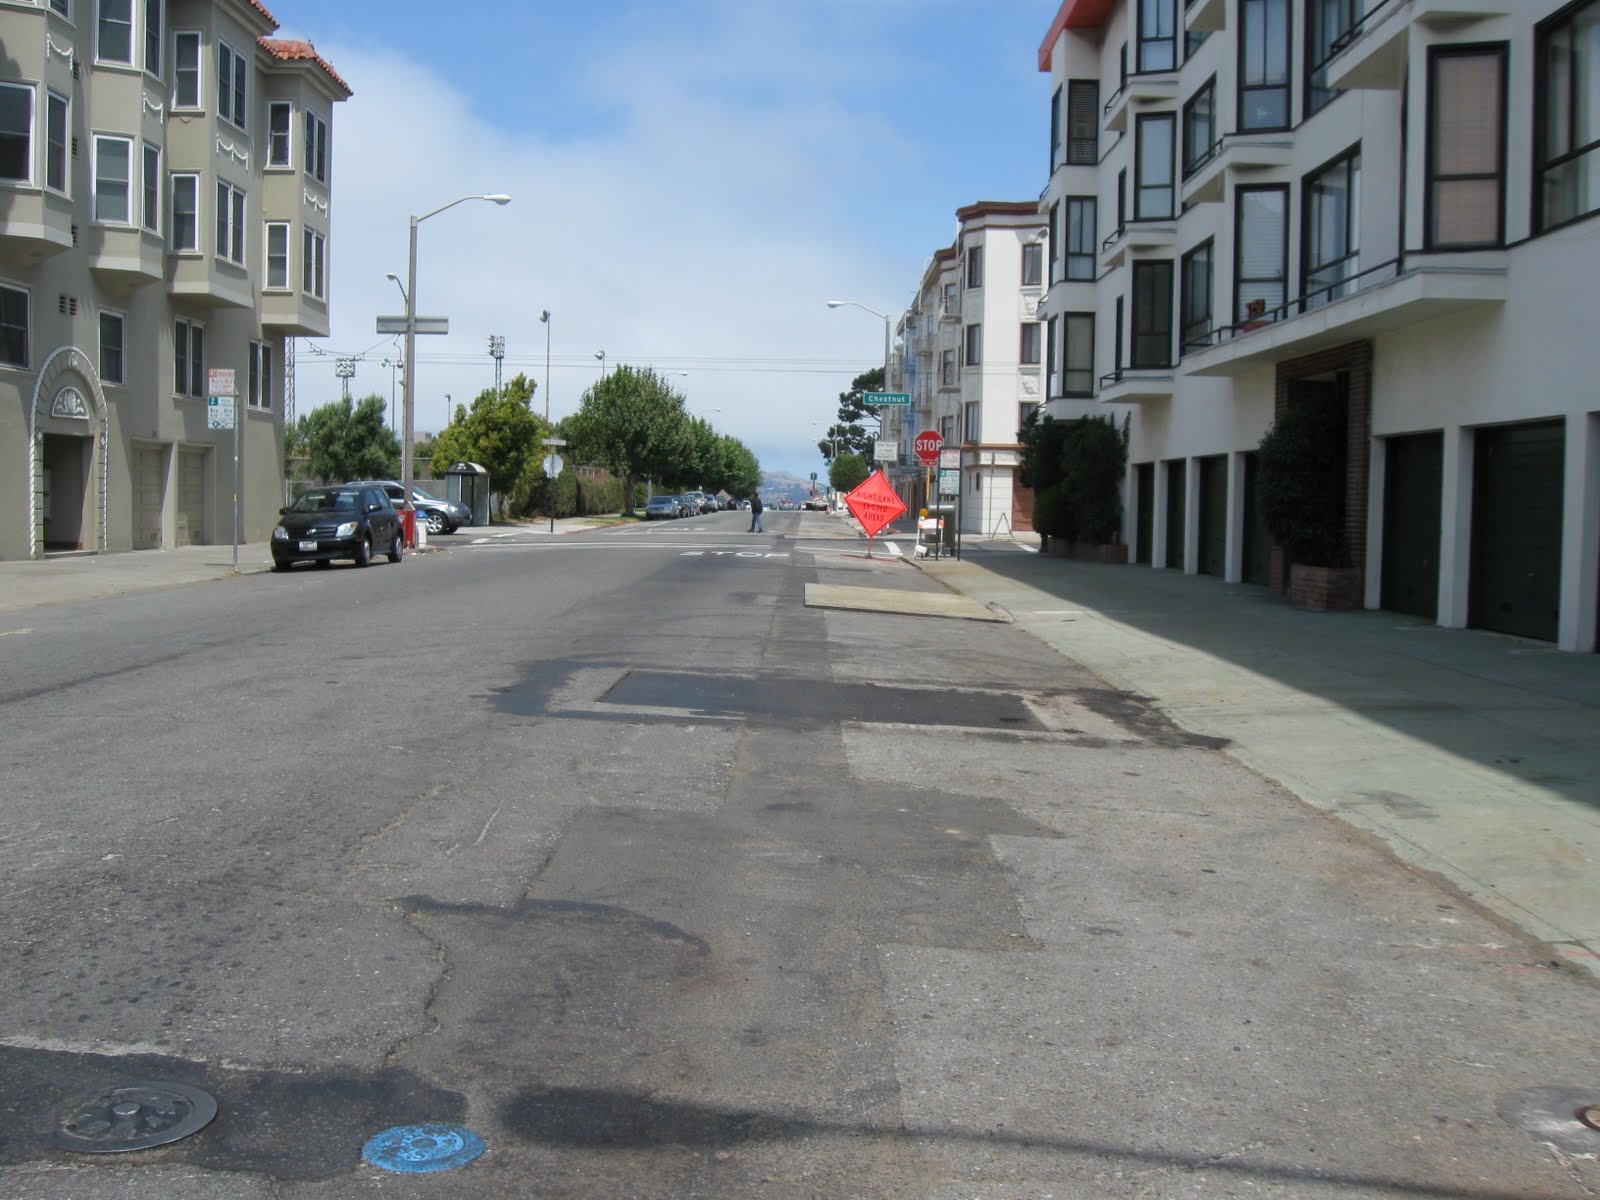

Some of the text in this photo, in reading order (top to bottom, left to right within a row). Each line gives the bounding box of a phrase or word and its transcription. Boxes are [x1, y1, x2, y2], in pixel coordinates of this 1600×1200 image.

[210, 397, 216, 405] 2
[868, 395, 905, 403] Chestnut
[916, 439, 943, 451] STOP
[857, 491, 896, 505] RIGHT LANE
[863, 503, 888, 513] CLOSED
[863, 512, 885, 523] AHEAD
